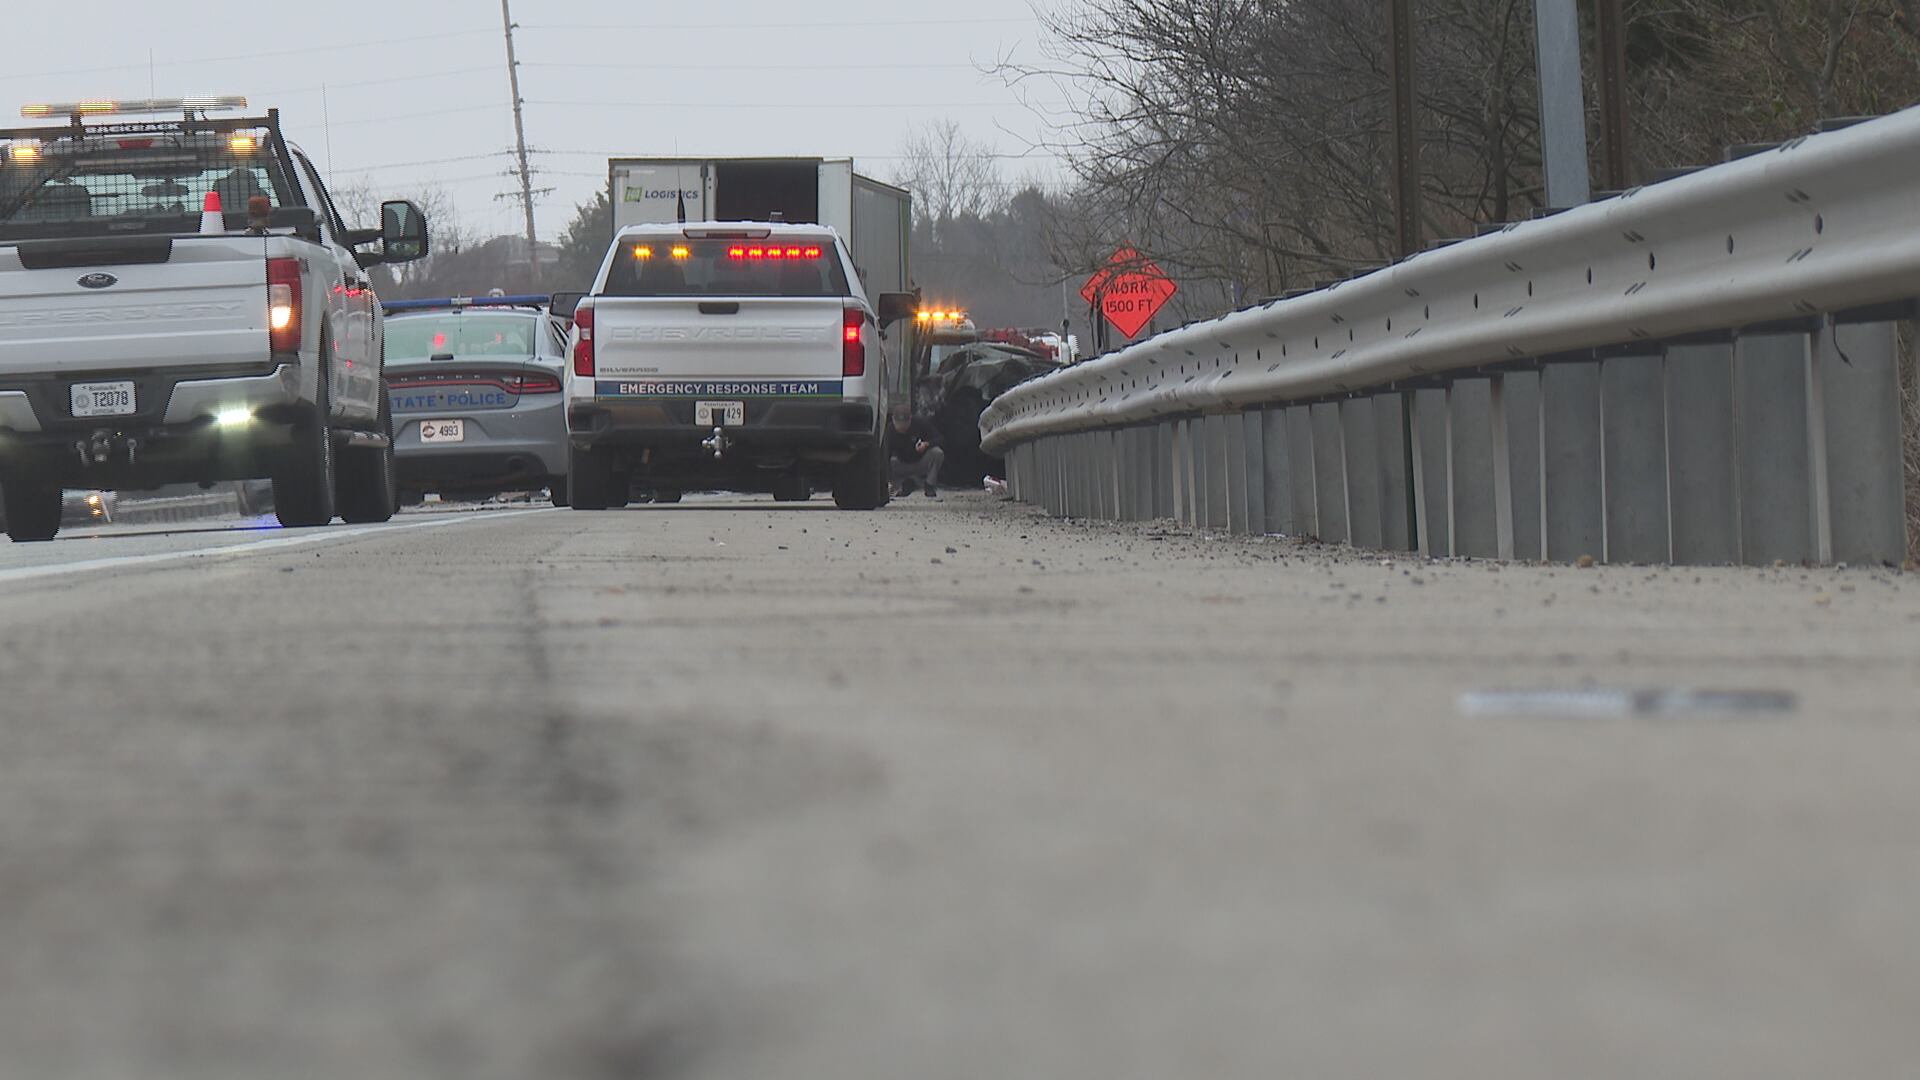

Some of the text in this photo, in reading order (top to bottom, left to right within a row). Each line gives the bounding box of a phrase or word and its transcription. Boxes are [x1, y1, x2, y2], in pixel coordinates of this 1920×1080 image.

[644, 190, 698, 199] LOGISICS
[1109, 281, 1148, 294] WORK
[1106, 299, 1153, 313] 1500 FT
[610, 326, 827, 341] CHEVROLET
[599, 366, 659, 374] SILVERADO
[619, 383, 818, 394] EMERGENCY RESPONSE TEAM
[92, 390, 129, 407] T2078
[447, 392, 506, 407] POLICE
[439, 425, 459, 436] 4993
